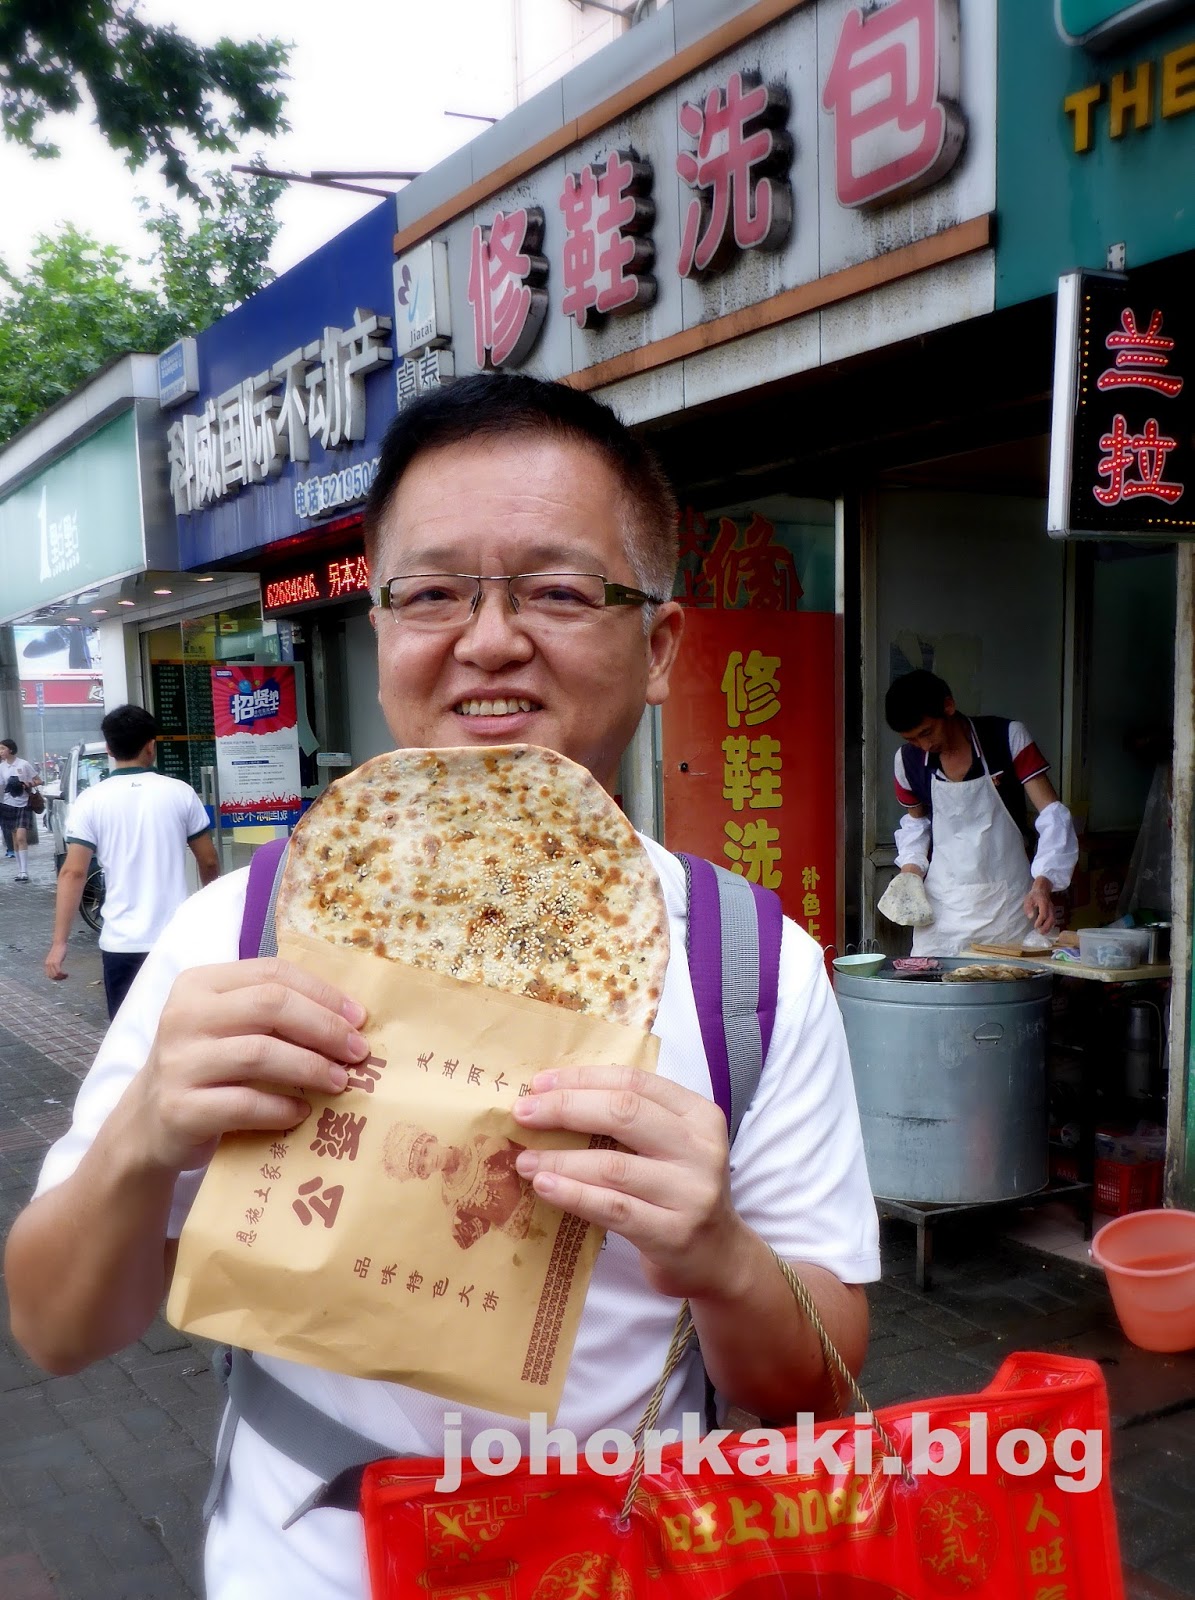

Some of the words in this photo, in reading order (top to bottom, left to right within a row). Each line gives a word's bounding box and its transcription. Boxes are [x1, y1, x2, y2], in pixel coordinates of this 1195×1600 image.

[1064, 42, 1195, 154] THE
[467, 0, 952, 369] 修鞋洗包
[409, 320, 433, 347] Jiatai
[168, 307, 393, 516] 科威国际不动产
[231, 688, 280, 724] 招贤纳士
[721, 649, 783, 891] 修鞋洗
[235, 1128, 293, 1248] 恩施土家族
[353, 1256, 500, 1313] 品味特色大饼
[662, 1475, 869, 1555] 旺上加旺
